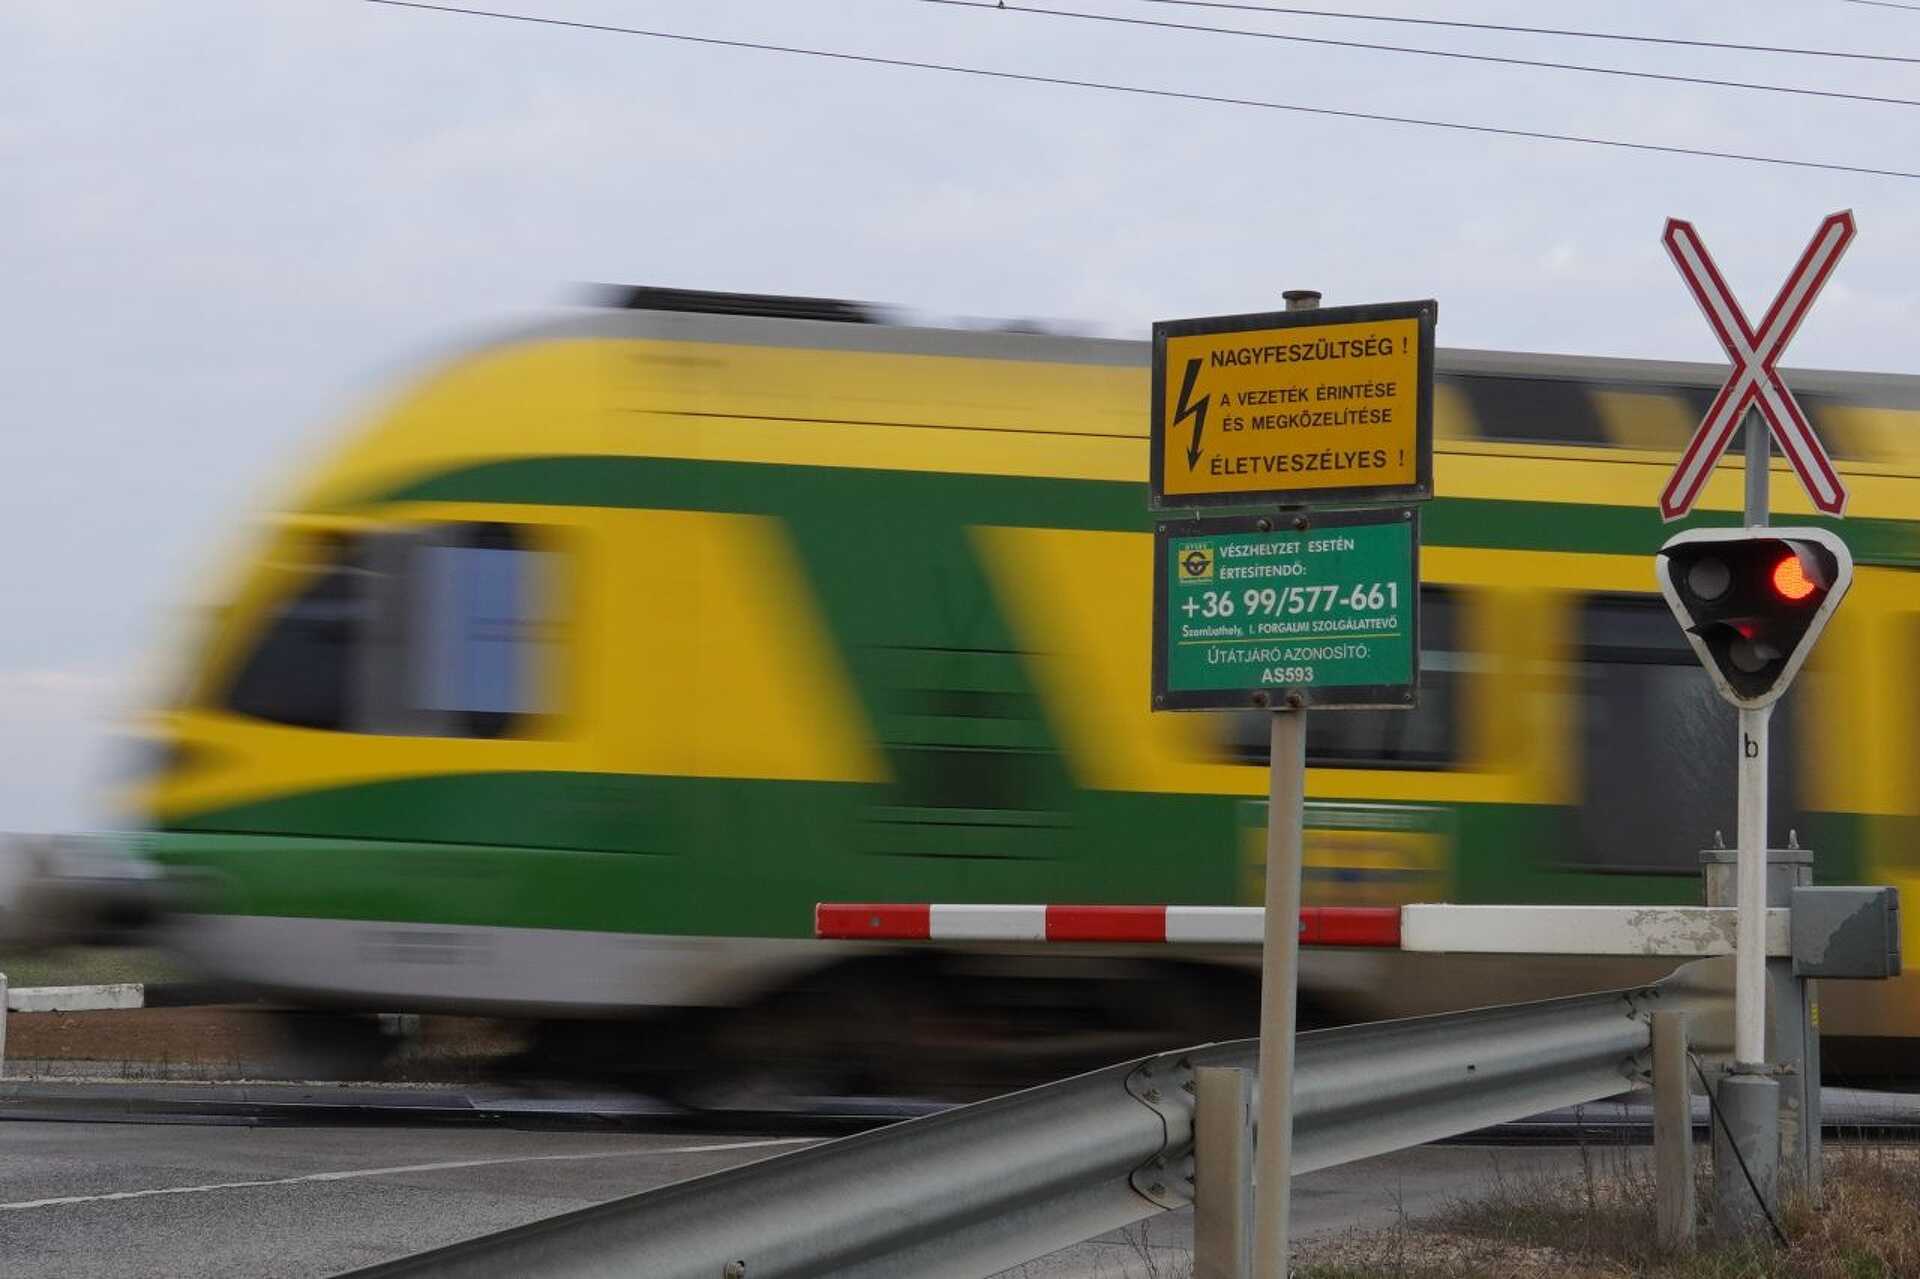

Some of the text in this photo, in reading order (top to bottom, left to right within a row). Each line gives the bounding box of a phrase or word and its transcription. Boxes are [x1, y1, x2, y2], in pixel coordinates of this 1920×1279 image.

[1211, 335, 1407, 368] NAGYFESZÜLTSÉG !
[1220, 380, 1396, 406] A VEZETÉK ÉRINTÉSE
[1223, 408, 1392, 431] ÉS MEGKÖZELÍTÉSE
[1211, 448, 1404, 475] ÉLETVESZÉLYES !
[1220, 541, 1300, 558] VÉSZHELYZET
[1308, 538, 1354, 553] ESETÉN
[1182, 582, 1397, 618] +36 99/577-661
[1258, 623, 1309, 633] FORGALMI
[1208, 644, 1371, 664] ÚTÁTJÁRÓ AZONOSÍTÓ:
[1262, 667, 1314, 683] AS593
